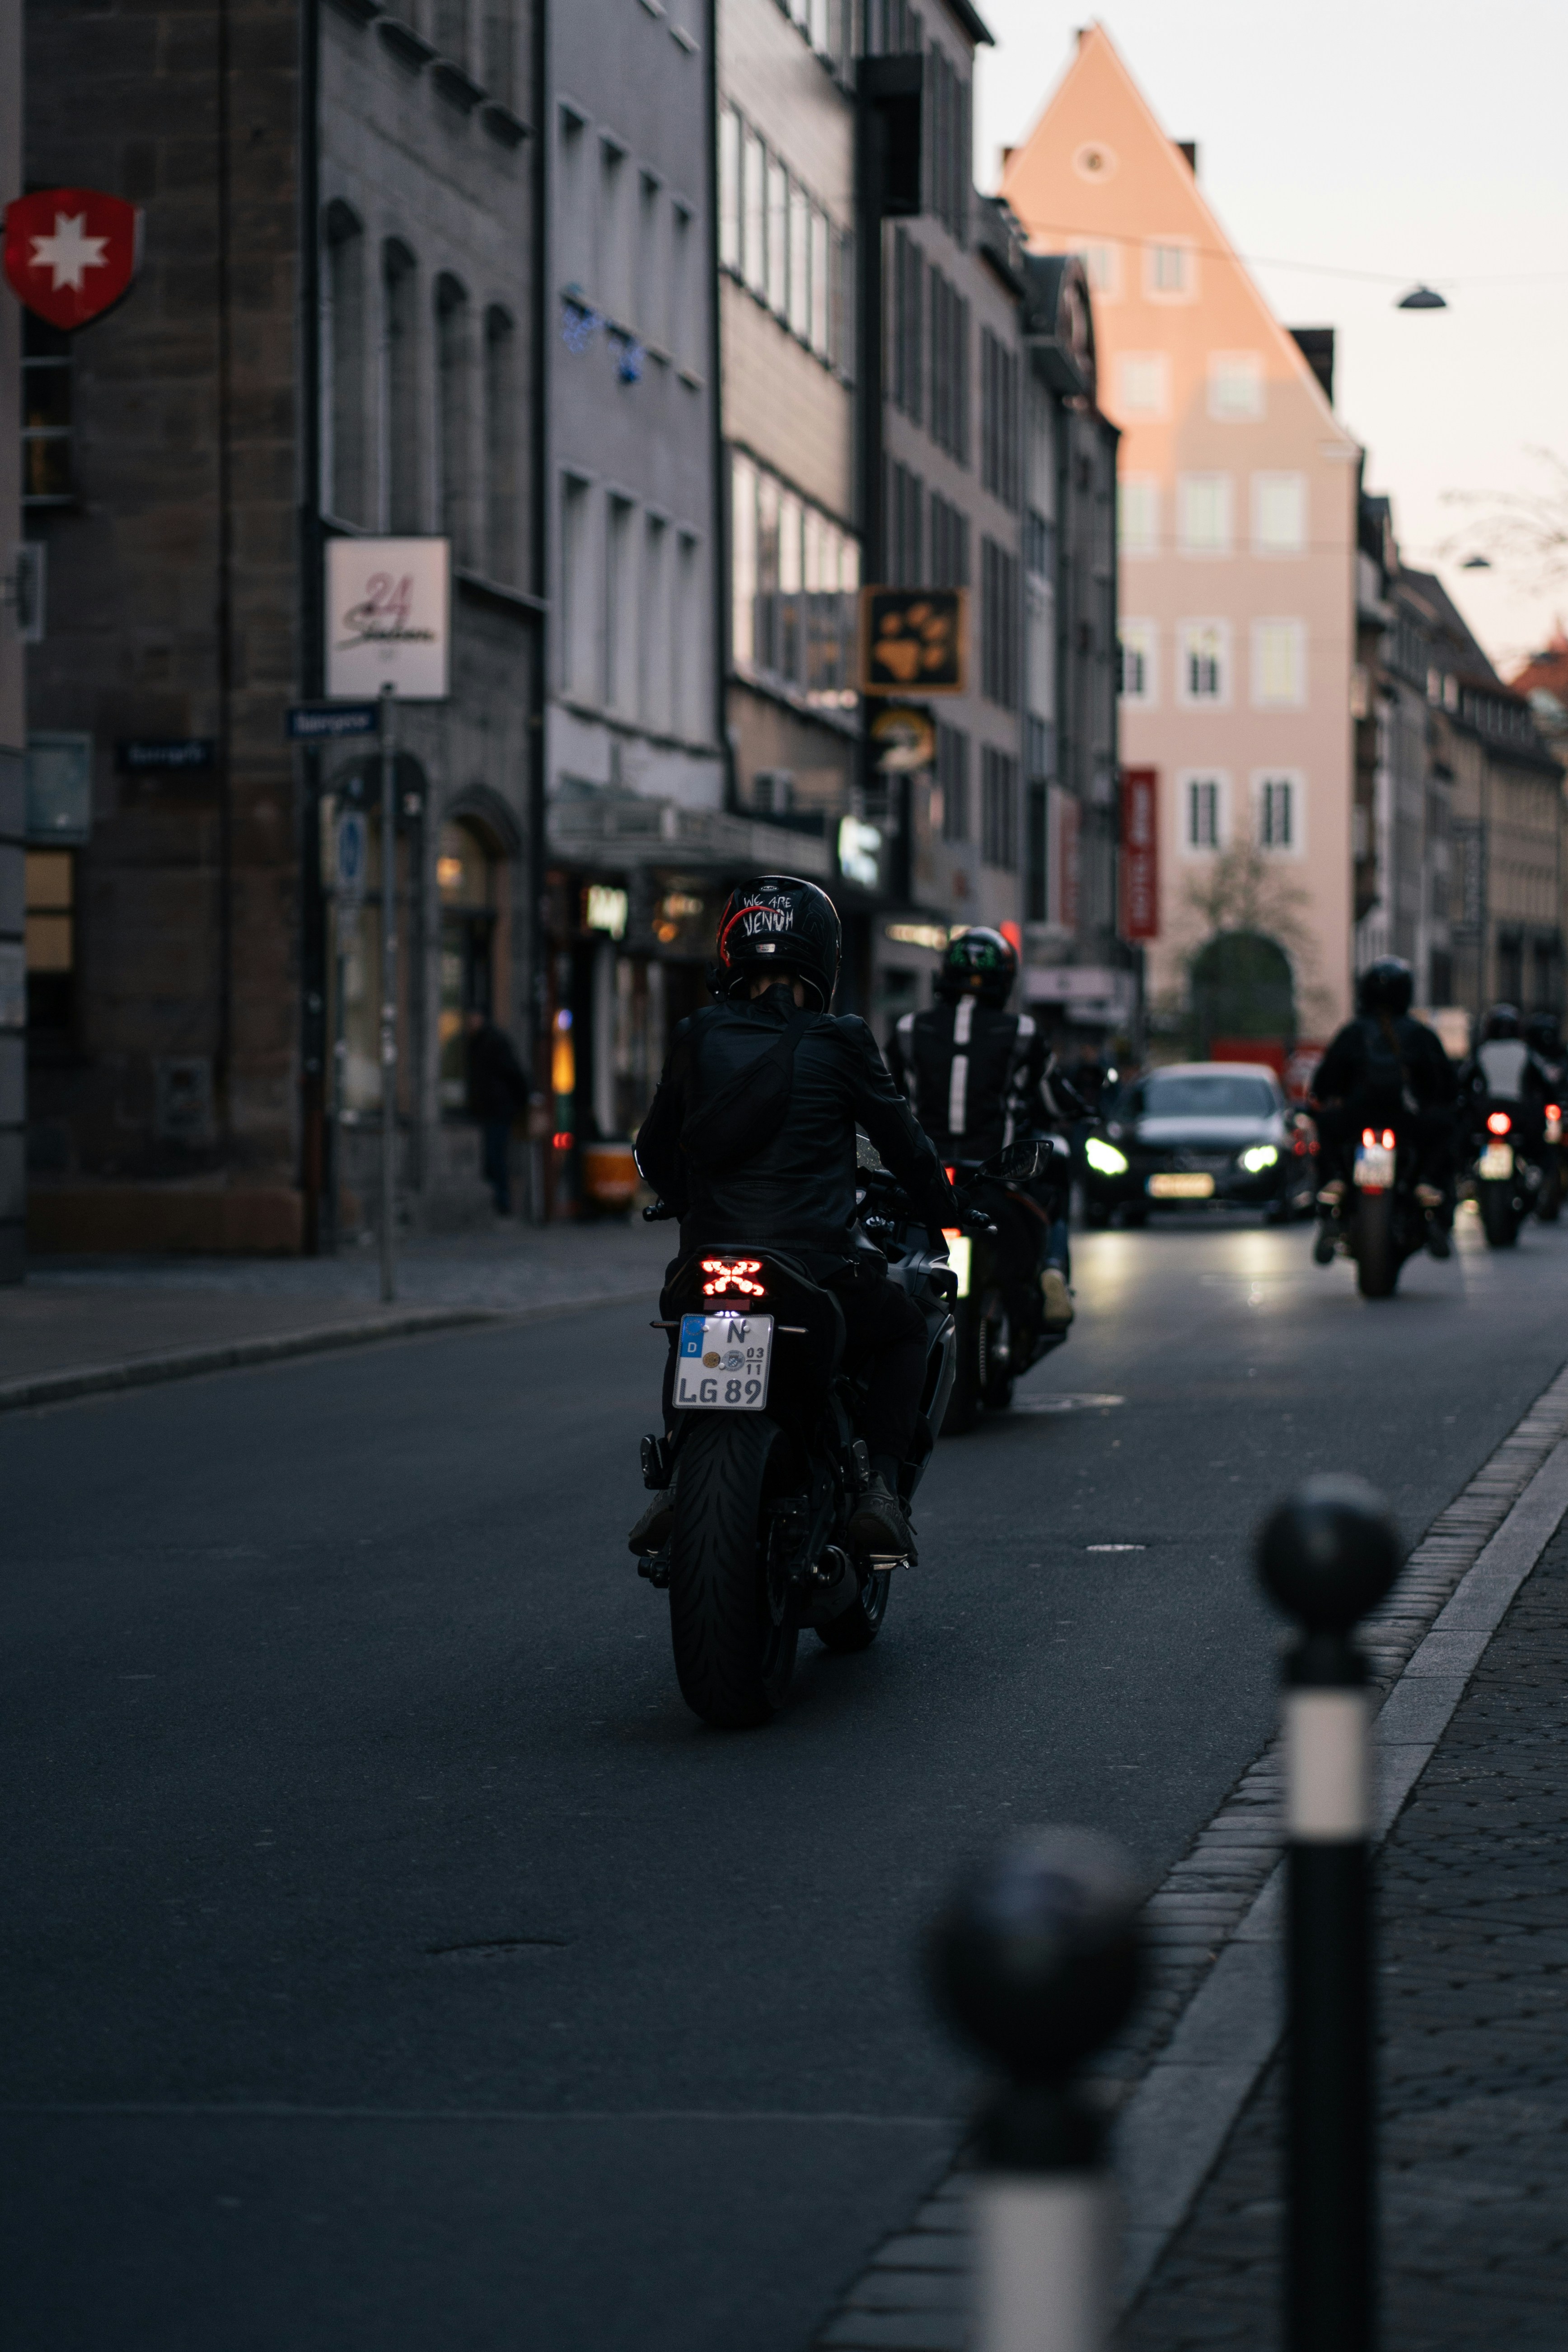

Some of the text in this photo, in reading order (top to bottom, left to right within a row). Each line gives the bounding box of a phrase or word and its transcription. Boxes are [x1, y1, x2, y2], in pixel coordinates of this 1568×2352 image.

[744, 894, 791, 909] WE ARE
[743, 908, 793, 937] VENOM
[727, 1319, 746, 1343] N
[687, 1342, 697, 1353] D
[747, 1347, 764, 1358] 03
[747, 1364, 761, 1375] 11
[679, 1378, 762, 1404] LG 89
